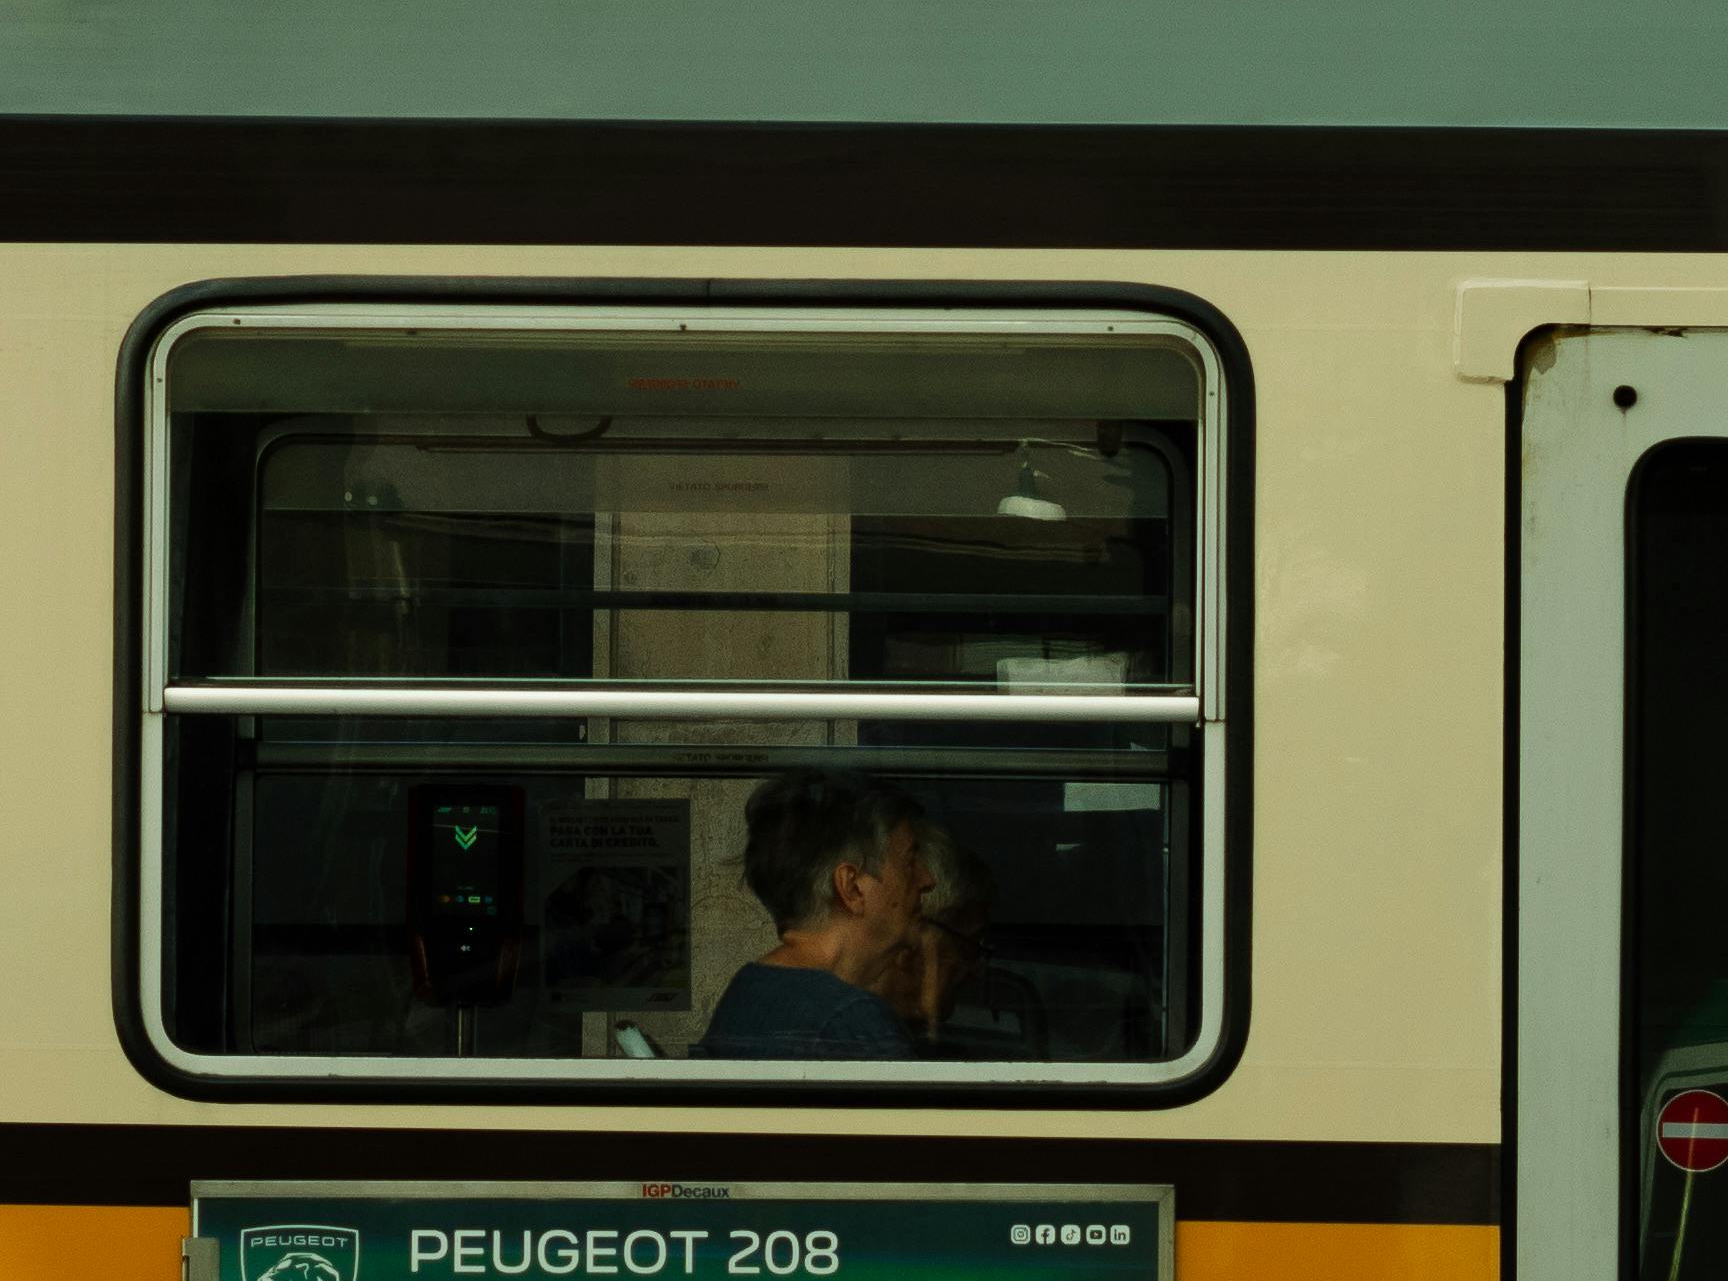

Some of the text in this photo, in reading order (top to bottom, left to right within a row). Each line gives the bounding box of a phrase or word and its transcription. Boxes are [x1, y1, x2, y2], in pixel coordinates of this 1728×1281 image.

[642, 1183, 730, 1198] IGPDecaux
[250, 1235, 350, 1248] PEUGEOT
[411, 1230, 839, 1275] PEUGEOT 208
